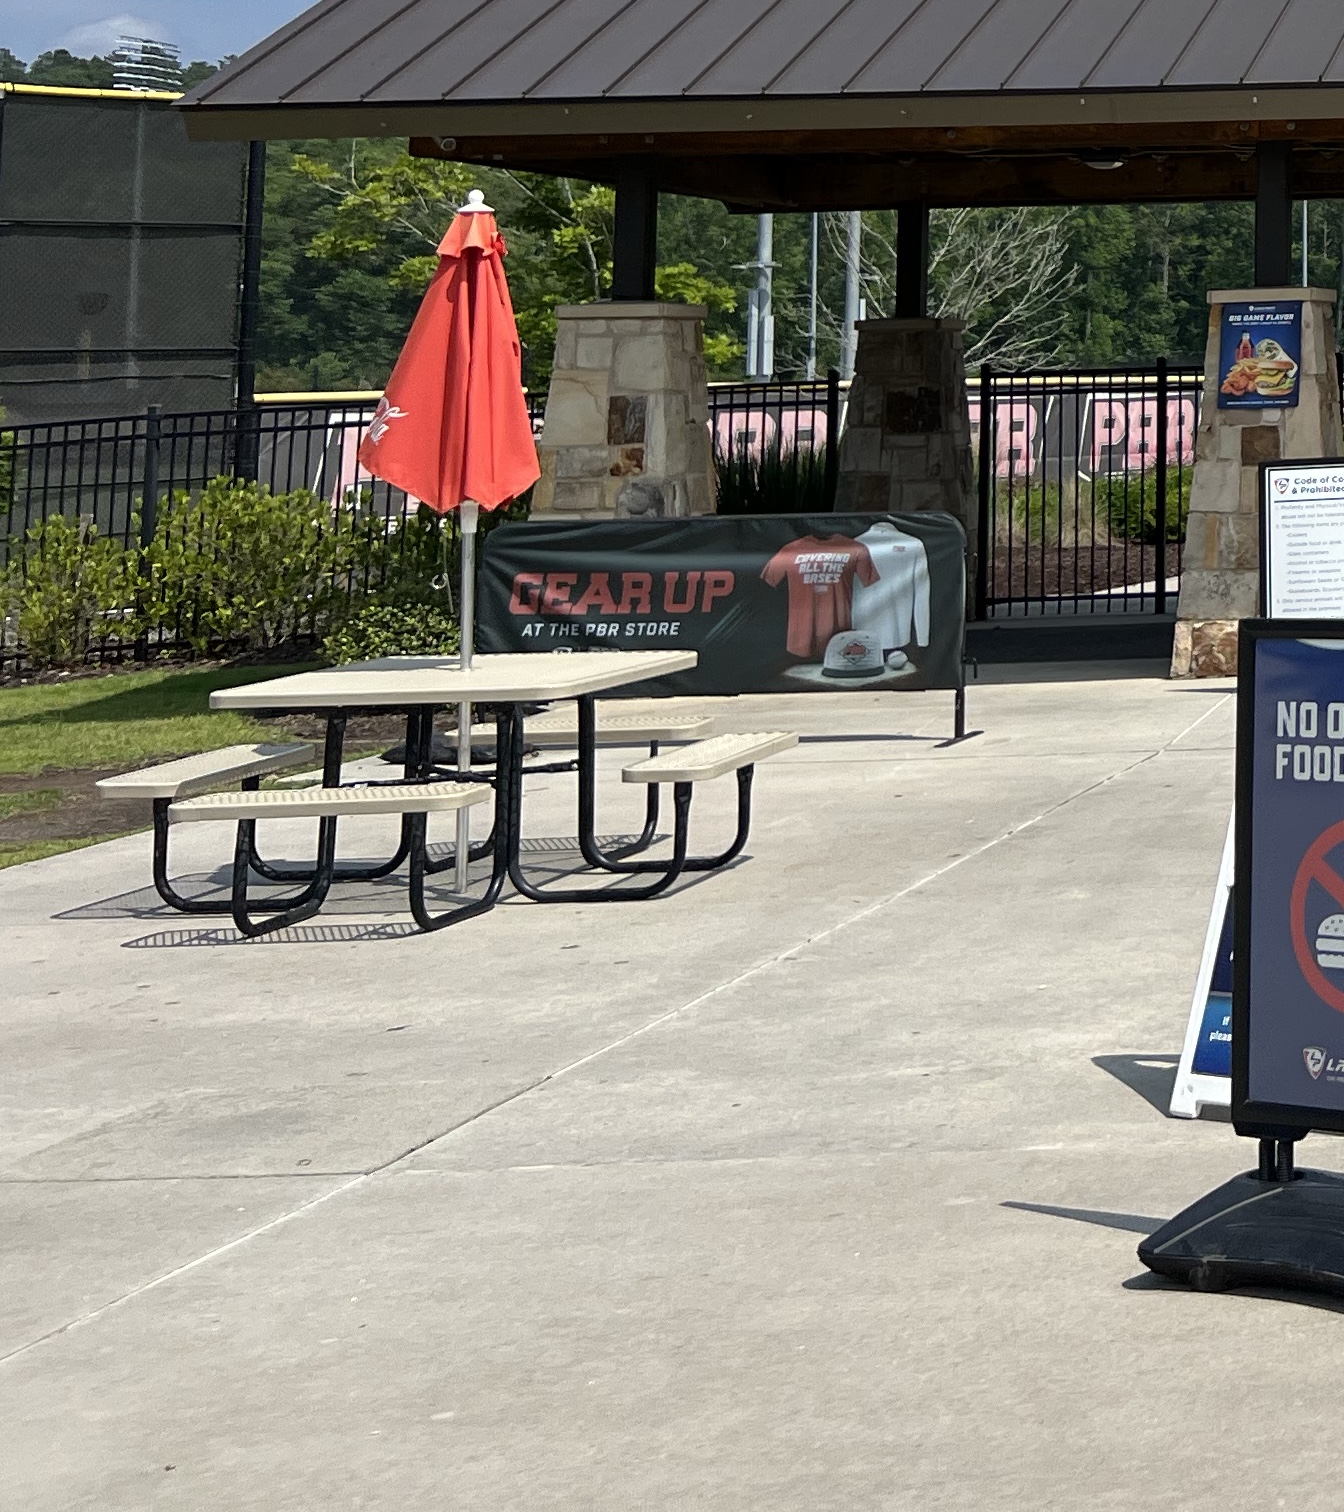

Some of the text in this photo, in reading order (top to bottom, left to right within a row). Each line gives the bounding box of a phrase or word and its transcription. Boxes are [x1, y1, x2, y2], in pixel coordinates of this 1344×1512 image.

[1243, 314, 1265, 322] GAME
[1265, 313, 1295, 321] FLAVOR
[1294, 477, 1317, 485] Code
[1319, 476, 1330, 484] of
[1291, 487, 1298, 495] &
[794, 552, 851, 564] COVERING
[799, 562, 845, 574] ALL THE
[803, 573, 841, 584] BASES
[508, 570, 735, 616] GEAR UP
[521, 621, 681, 637] AT THE PBR STORE
[1276, 700, 1318, 738] NO
